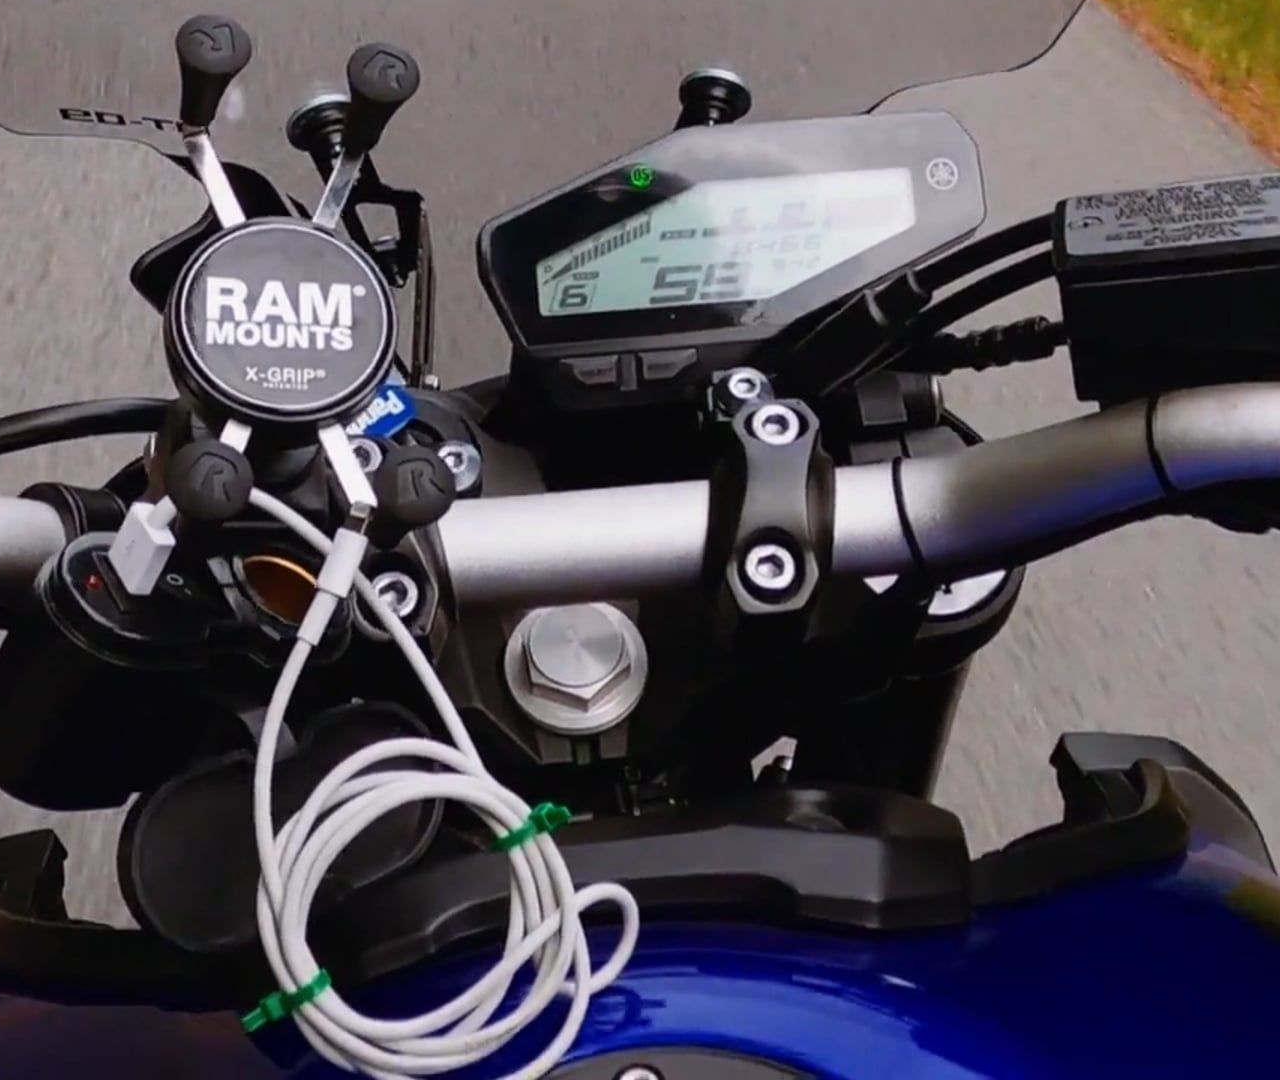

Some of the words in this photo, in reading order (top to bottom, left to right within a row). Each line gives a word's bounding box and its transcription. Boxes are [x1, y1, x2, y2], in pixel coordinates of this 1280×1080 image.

[205, 276, 353, 327] RAM
[559, 283, 589, 309] 6
[206, 321, 353, 351] MOUNTS
